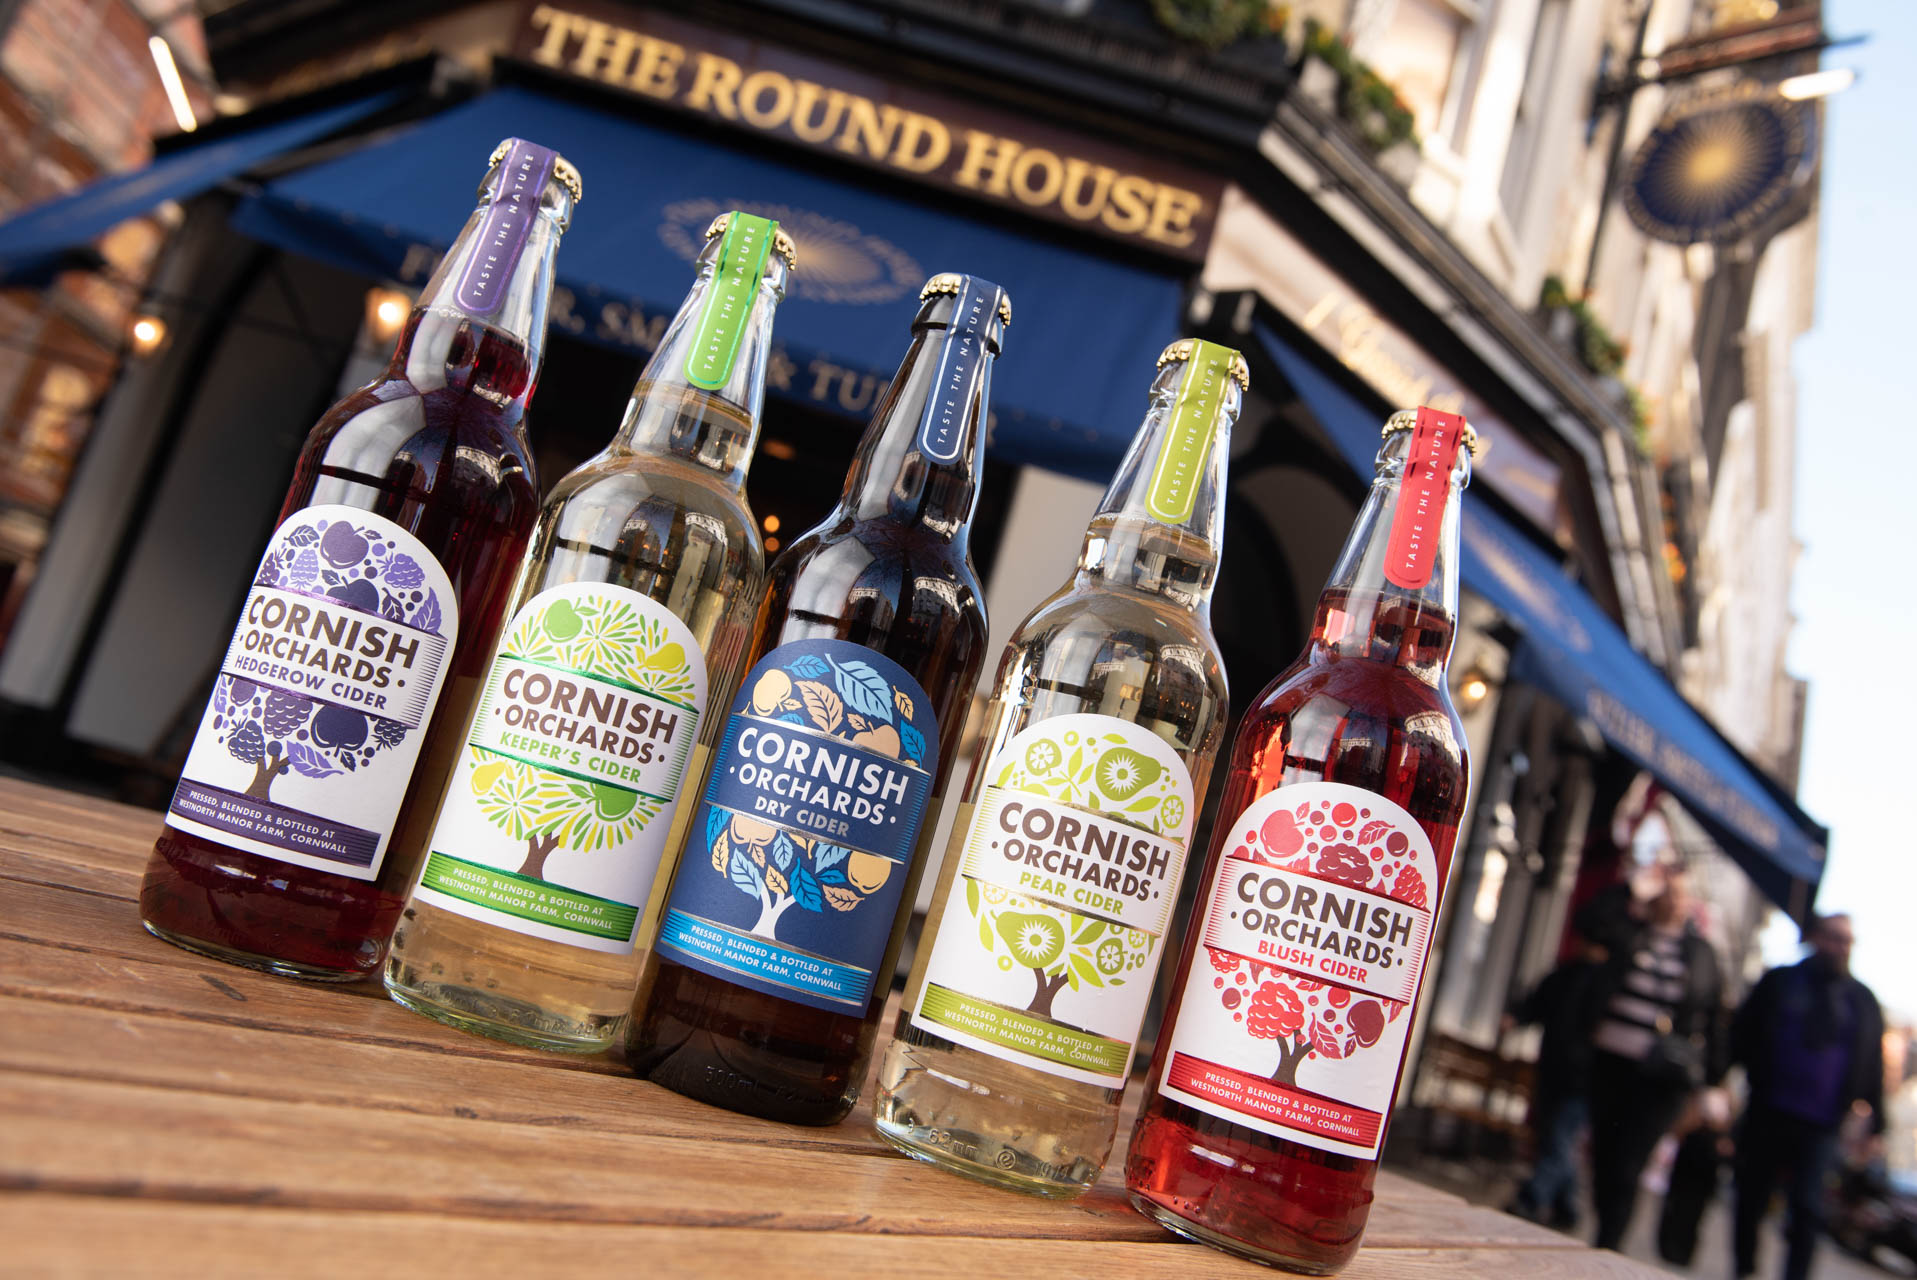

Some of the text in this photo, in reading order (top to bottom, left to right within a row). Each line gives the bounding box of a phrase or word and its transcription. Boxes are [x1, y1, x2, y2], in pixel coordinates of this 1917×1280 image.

[531, 6, 1199, 247] THE ROUND HOUSE
[473, 153, 534, 297] TASTE THE NATURE
[704, 227, 756, 370] TASTE THE NATURE
[937, 296, 984, 444] TASTE THE NATURE
[1166, 359, 1218, 504] TASTE THE NATURE
[1406, 420, 1446, 569] TASTE THE NATURE
[244, 628, 391, 689] ORCHARDS
[248, 594, 420, 670] CORNISH
[234, 654, 387, 711] HEDGEROW CIDER
[503, 668, 678, 745] CORNISH
[500, 731, 642, 784] KEEPER'S CIDER
[504, 704, 654, 765] ORCHARDS
[737, 726, 910, 807] CORNISH
[738, 762, 886, 825] ORCHARDS
[179, 798, 347, 854] WESTNORTH MANOR FARM, CORNWALL
[189, 790, 335, 839] PRESSED, BLENDED & BOTTLED AT
[754, 795, 850, 838] DRY CIDER
[999, 801, 1172, 883] CORNISH
[453, 867, 604, 915] PRESSED, BLENDED & BOTTLED AT
[1003, 838, 1151, 903] ORCHARDS
[1019, 870, 1124, 916] PEAR CIDER
[438, 875, 613, 929] WESTNORTH MANOR FARM, CORNWALL
[1237, 871, 1414, 948] CORNISH
[678, 932, 842, 991] WESTNORTH MANOR FARM, CORNWALL
[691, 925, 833, 977] PRESSED, BLENDED & BOTTLED AT
[1242, 908, 1393, 969] ORCHARDS
[1257, 940, 1369, 985] BLUSH CIDER
[945, 1009, 1110, 1066] WESTNORTH MANOR FARM, CORNWALL
[959, 1003, 1104, 1054] PRESSED, BLENDED & BOTTLED AT
[1191, 1078, 1359, 1136] WESTNORTH MANOR FARM, CORNWALL
[1205, 1072, 1352, 1123] PRESSED, BLENDED & BOTTLED AT
